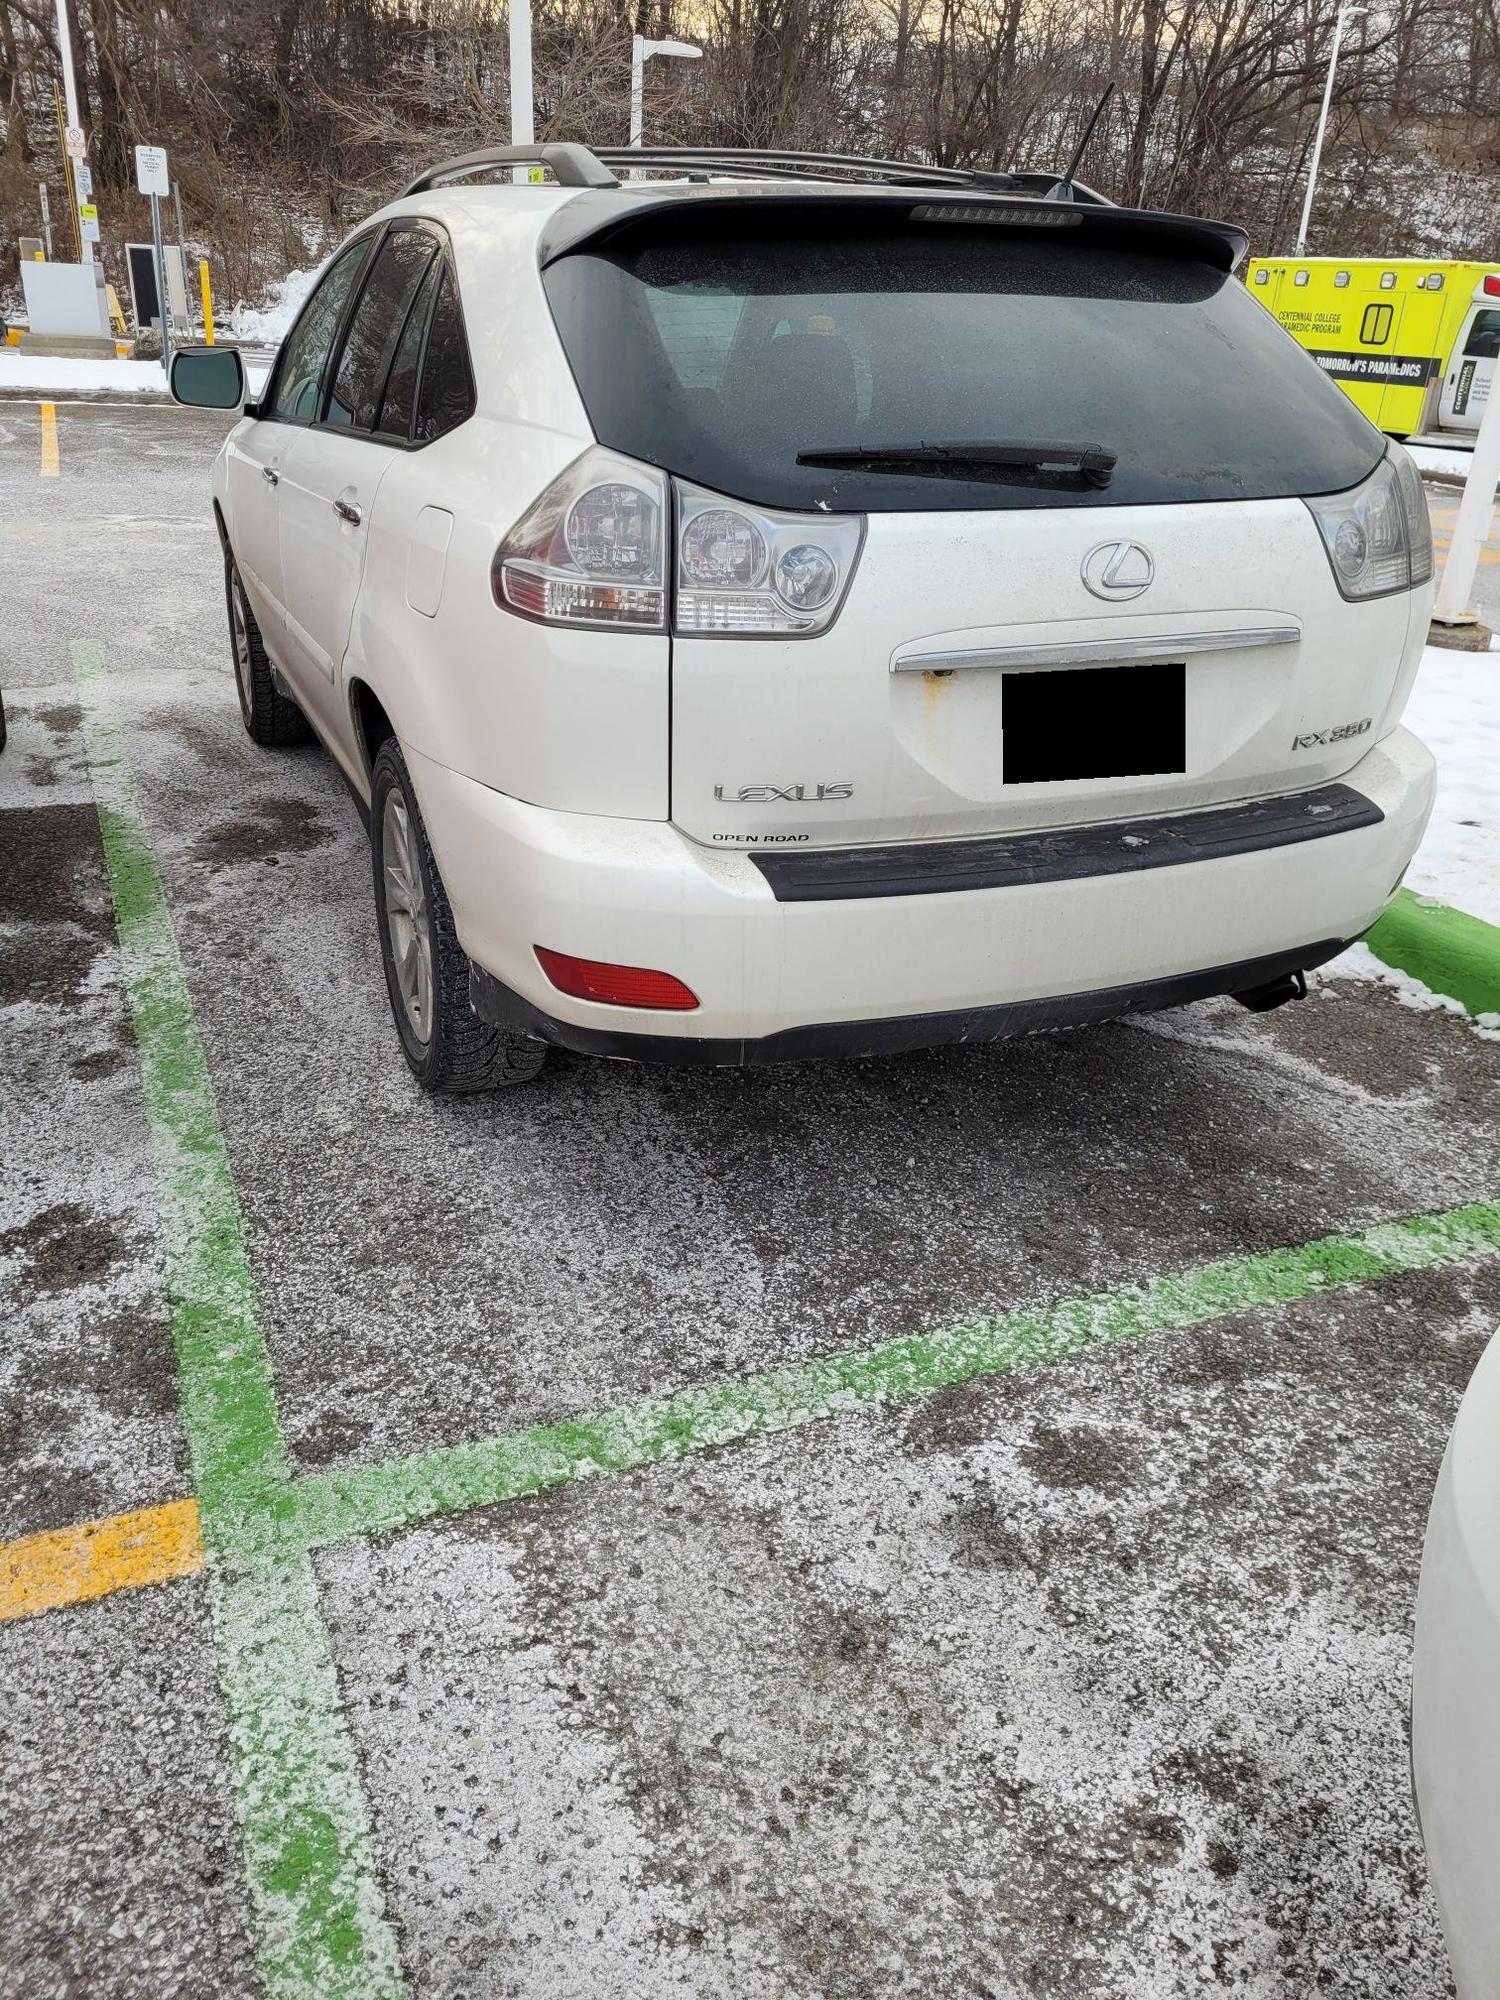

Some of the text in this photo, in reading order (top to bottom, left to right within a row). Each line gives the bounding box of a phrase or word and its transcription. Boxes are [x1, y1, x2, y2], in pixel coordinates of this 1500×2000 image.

[1279, 311, 1341, 323] CENTENNIAL COLLEGE
[1311, 323, 1341, 334] PROGRAM
[1291, 717, 1372, 751] RX 350
[714, 781, 853, 801] LEXUS
[712, 833, 809, 842] OPEN ROAD
